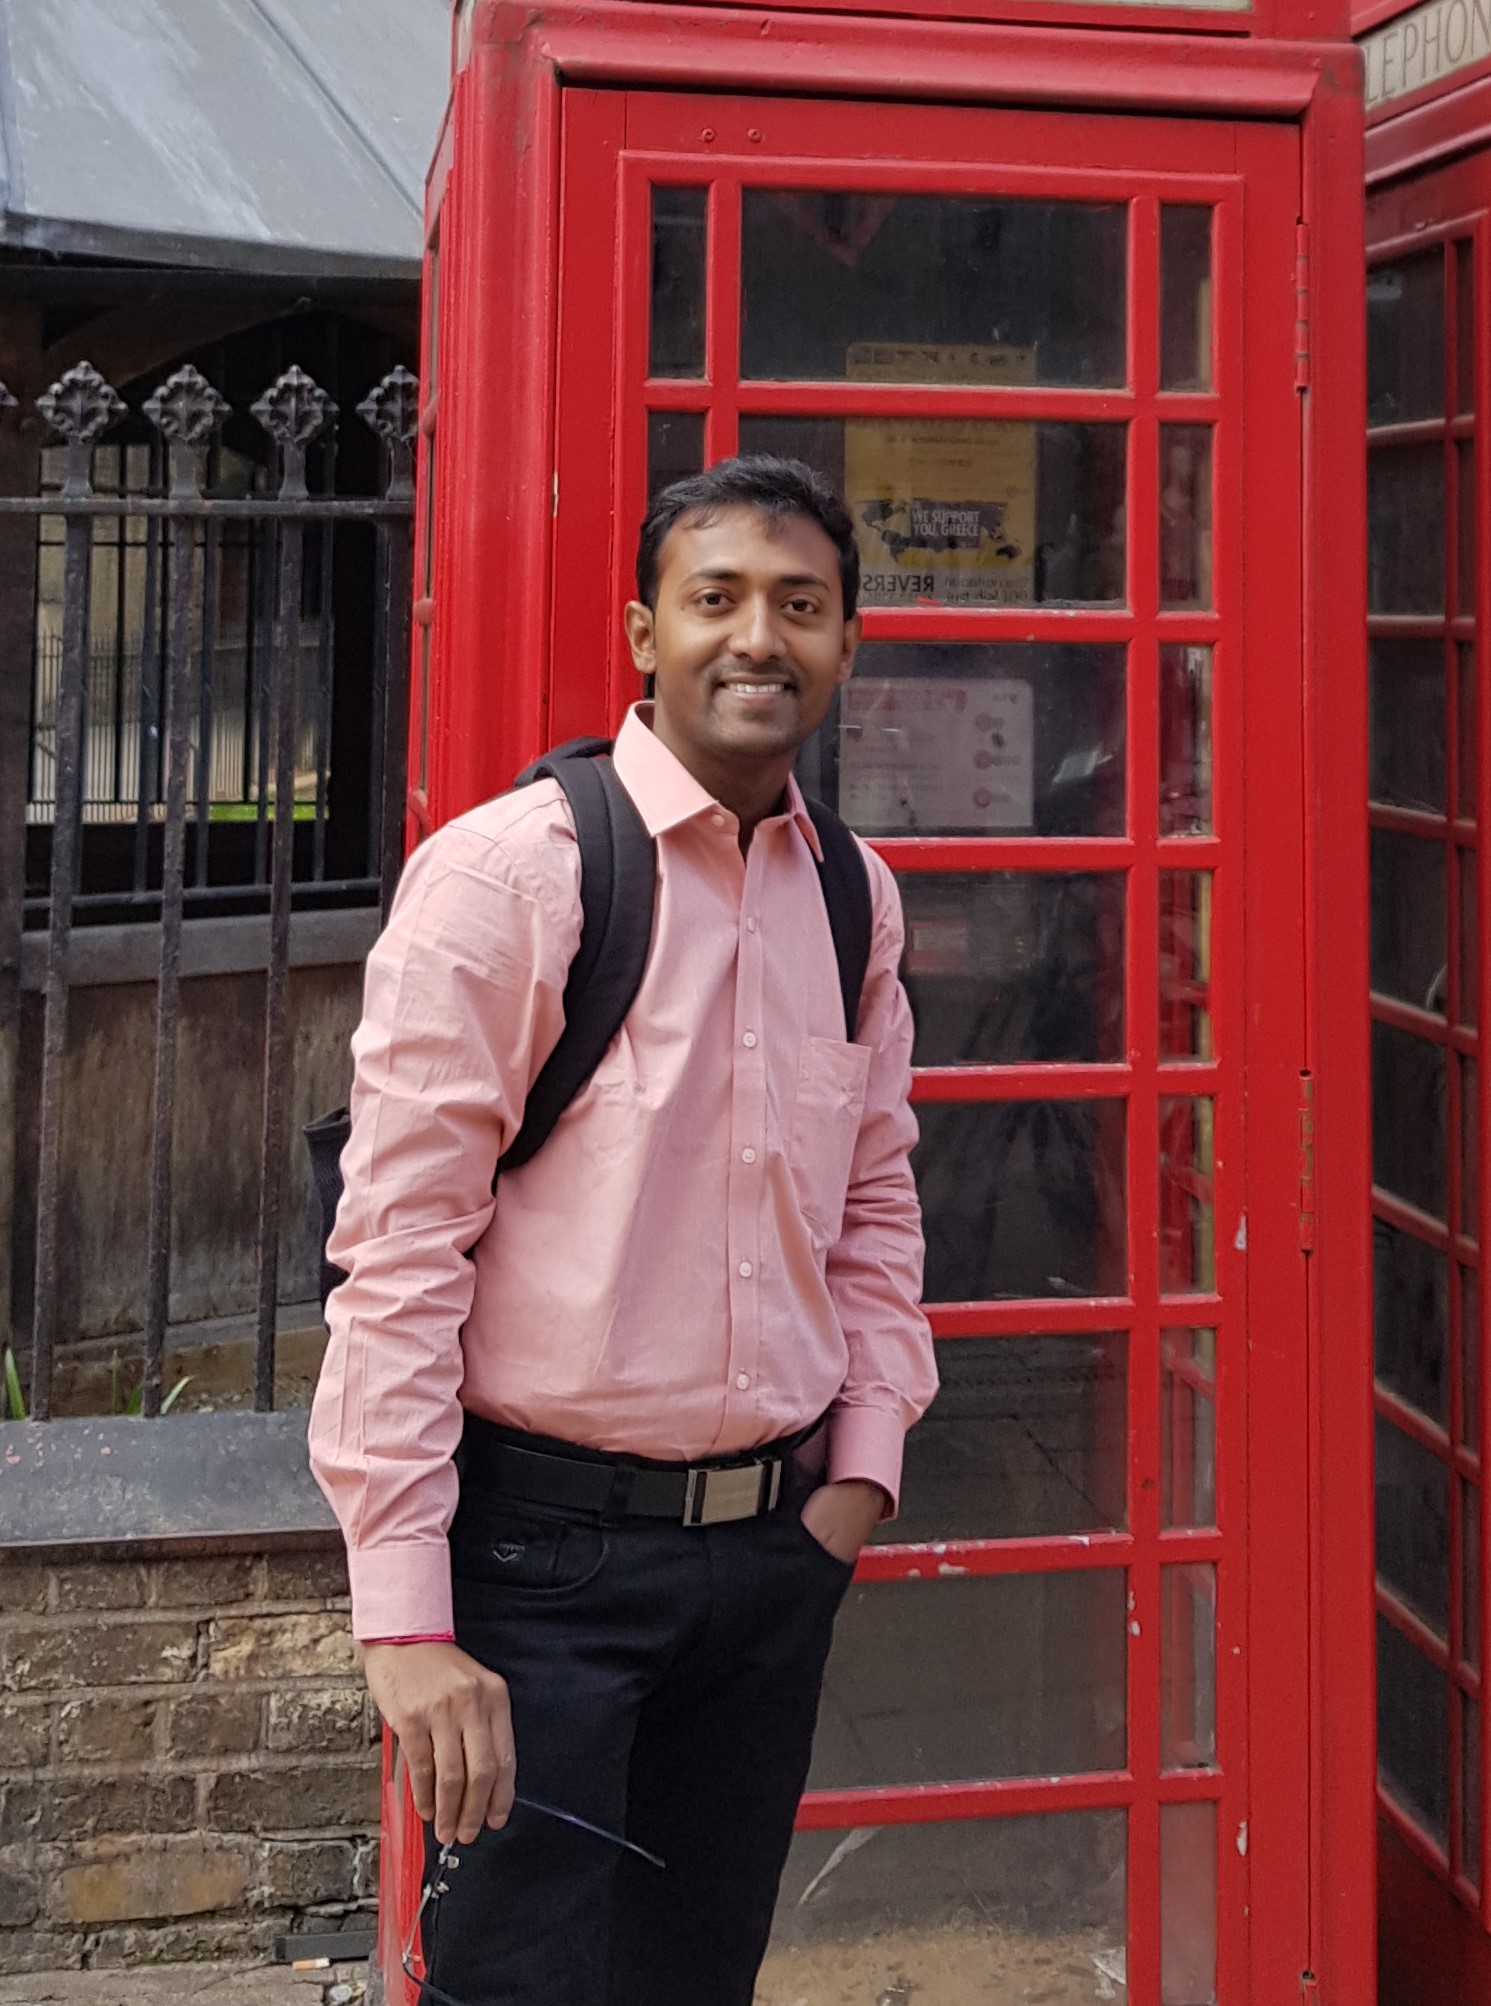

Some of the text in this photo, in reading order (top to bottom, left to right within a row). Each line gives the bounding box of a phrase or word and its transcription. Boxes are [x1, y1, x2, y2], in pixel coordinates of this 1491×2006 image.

[912, 510, 980, 523] WE SUPPORT
[941, 523, 979, 537] GREECE
